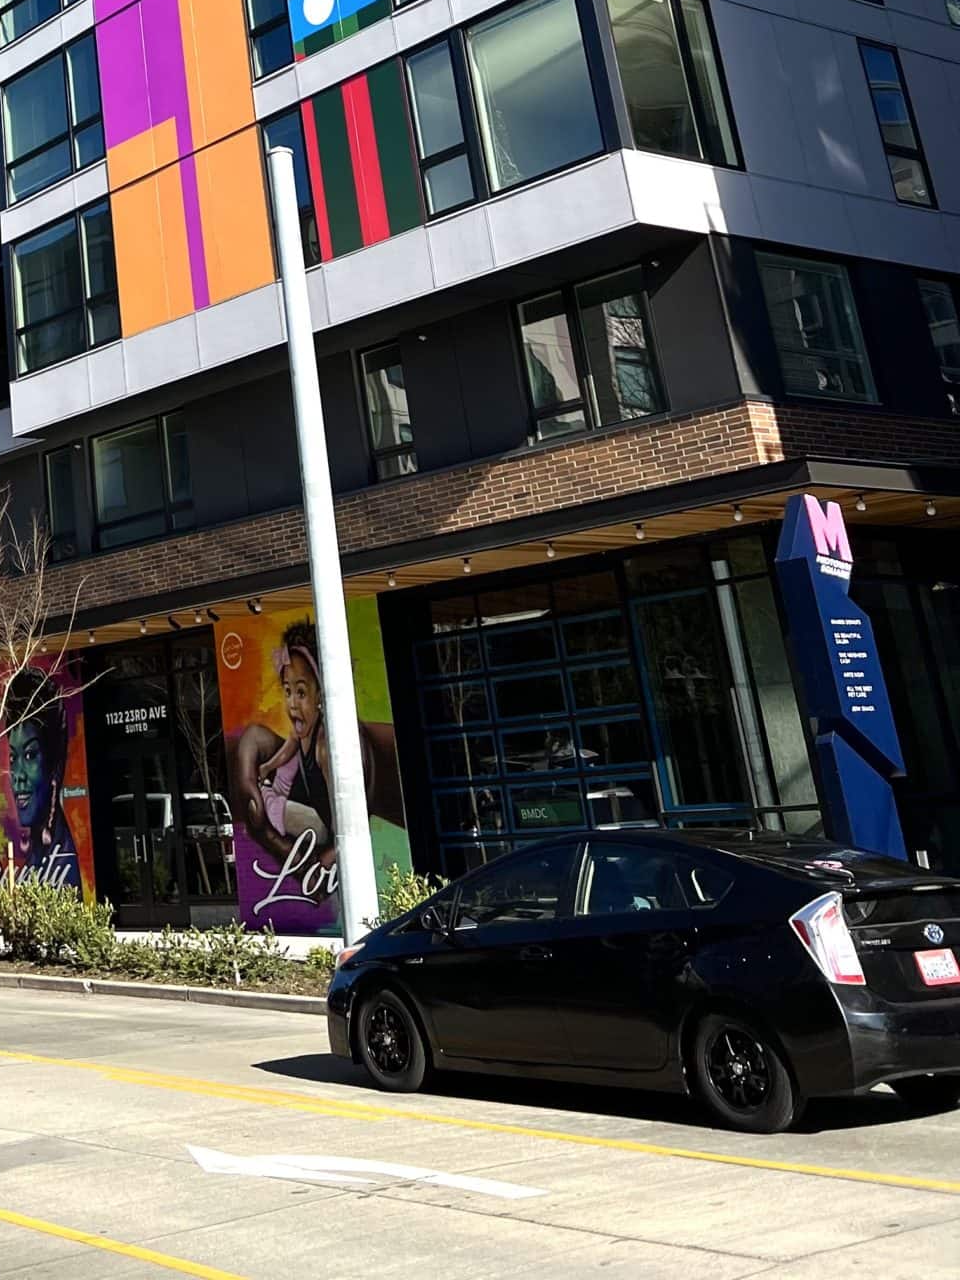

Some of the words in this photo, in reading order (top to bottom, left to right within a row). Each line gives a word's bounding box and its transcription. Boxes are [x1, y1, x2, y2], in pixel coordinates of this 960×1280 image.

[804, 493, 853, 562] M
[105, 712, 124, 725] 1122
[124, 708, 147, 723] 23RD
[148, 705, 167, 720] AVE
[125, 723, 142, 734] SUITE
